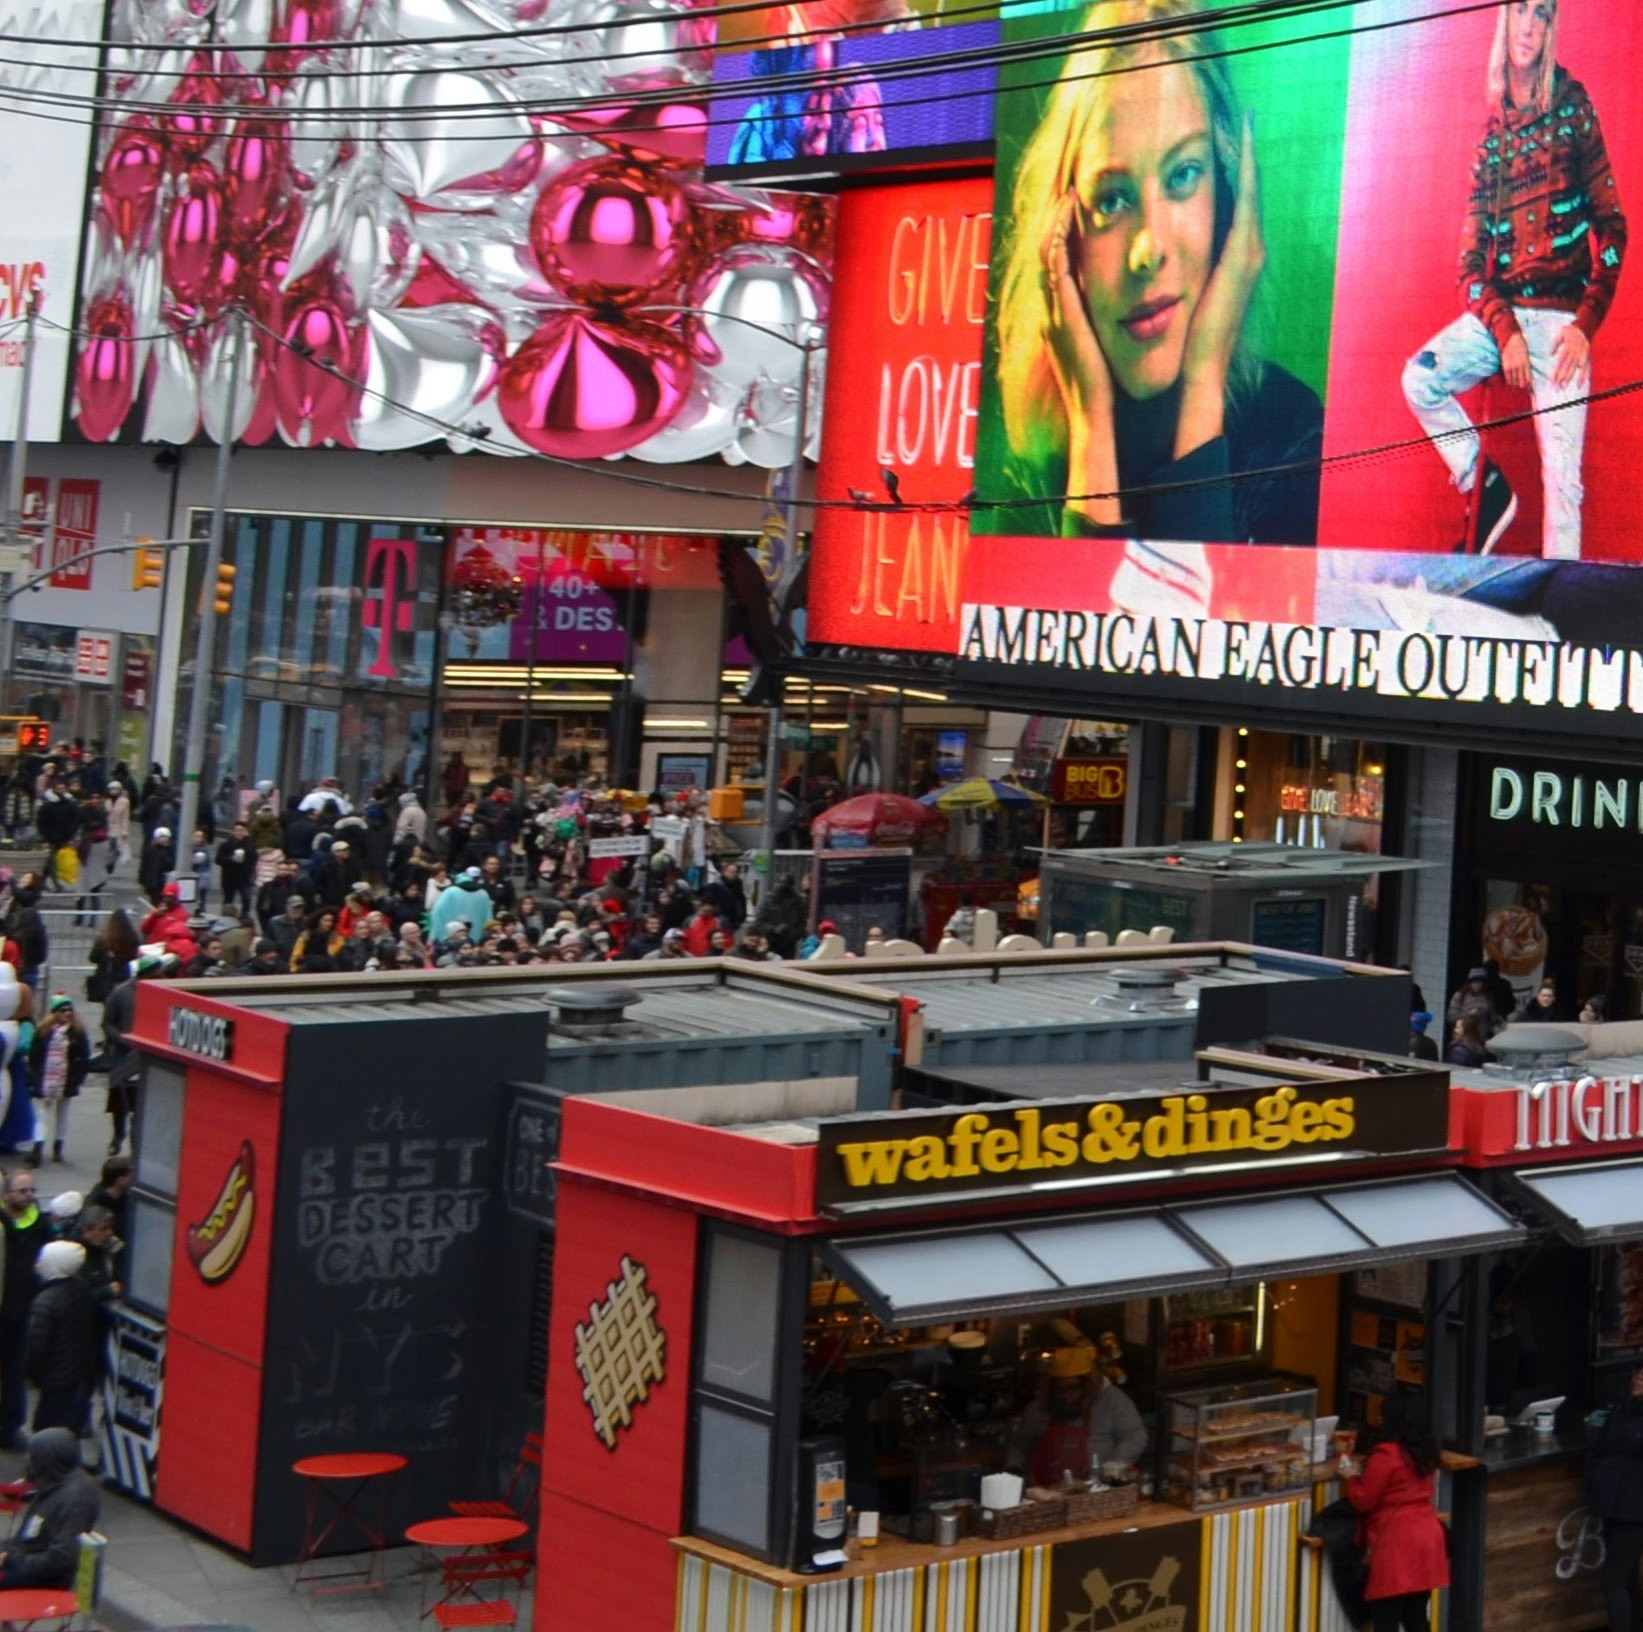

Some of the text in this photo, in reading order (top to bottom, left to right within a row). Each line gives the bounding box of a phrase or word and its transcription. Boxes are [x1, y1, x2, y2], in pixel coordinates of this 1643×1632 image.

[965, 611, 1207, 679] AMERICAN
[1222, 621, 1381, 690] EAGLE
[1065, 783, 1098, 801] BUS
[1066, 766, 1098, 784] BIG
[1311, 788, 1339, 816] LOVE
[167, 1006, 231, 1059] HOTDOGS
[837, 1087, 1355, 1186] wafels&dinges
[303, 1139, 488, 1196] BEST
[302, 1189, 488, 1246] DESSERT
[314, 1234, 447, 1286] CART
